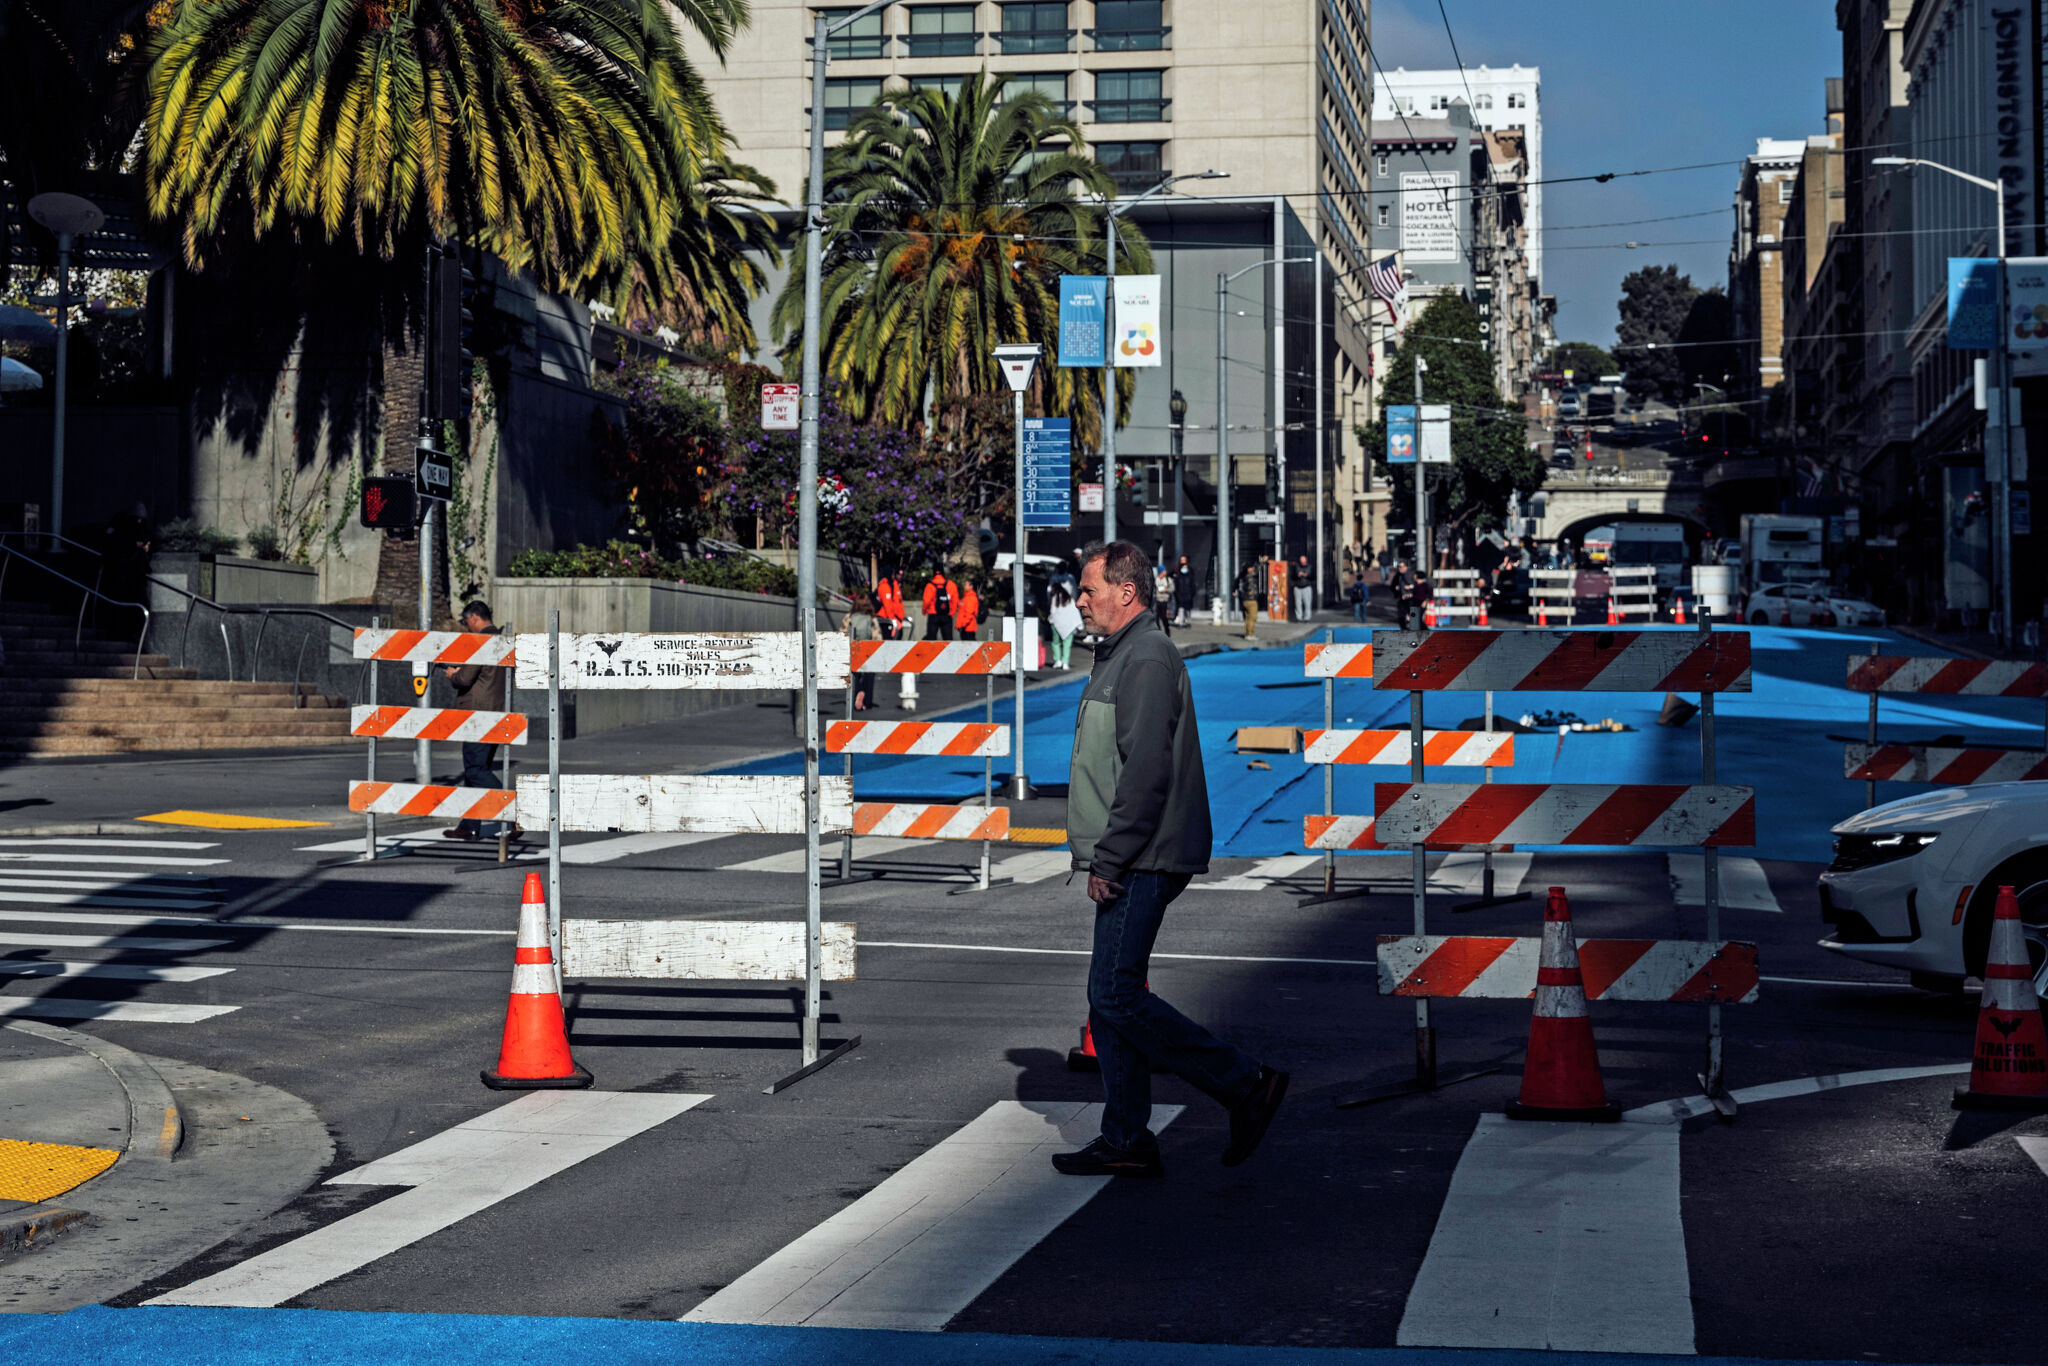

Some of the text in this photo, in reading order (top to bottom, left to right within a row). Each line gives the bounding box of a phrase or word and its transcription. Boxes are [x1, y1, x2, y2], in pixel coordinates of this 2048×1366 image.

[1992, 8, 2021, 158] JOHNSTON
[1405, 202, 1453, 212] HOTEL
[1478, 303, 1490, 352] HOT
[1029, 431, 1035, 442] 8
[1026, 467, 1037, 478] 30
[1026, 479, 1037, 490] 45
[1026, 491, 1036, 502] 91
[653, 639, 698, 650] SERVICE
[685, 651, 721, 661] SALES
[1981, 1042, 2036, 1057] TRAFFIC
